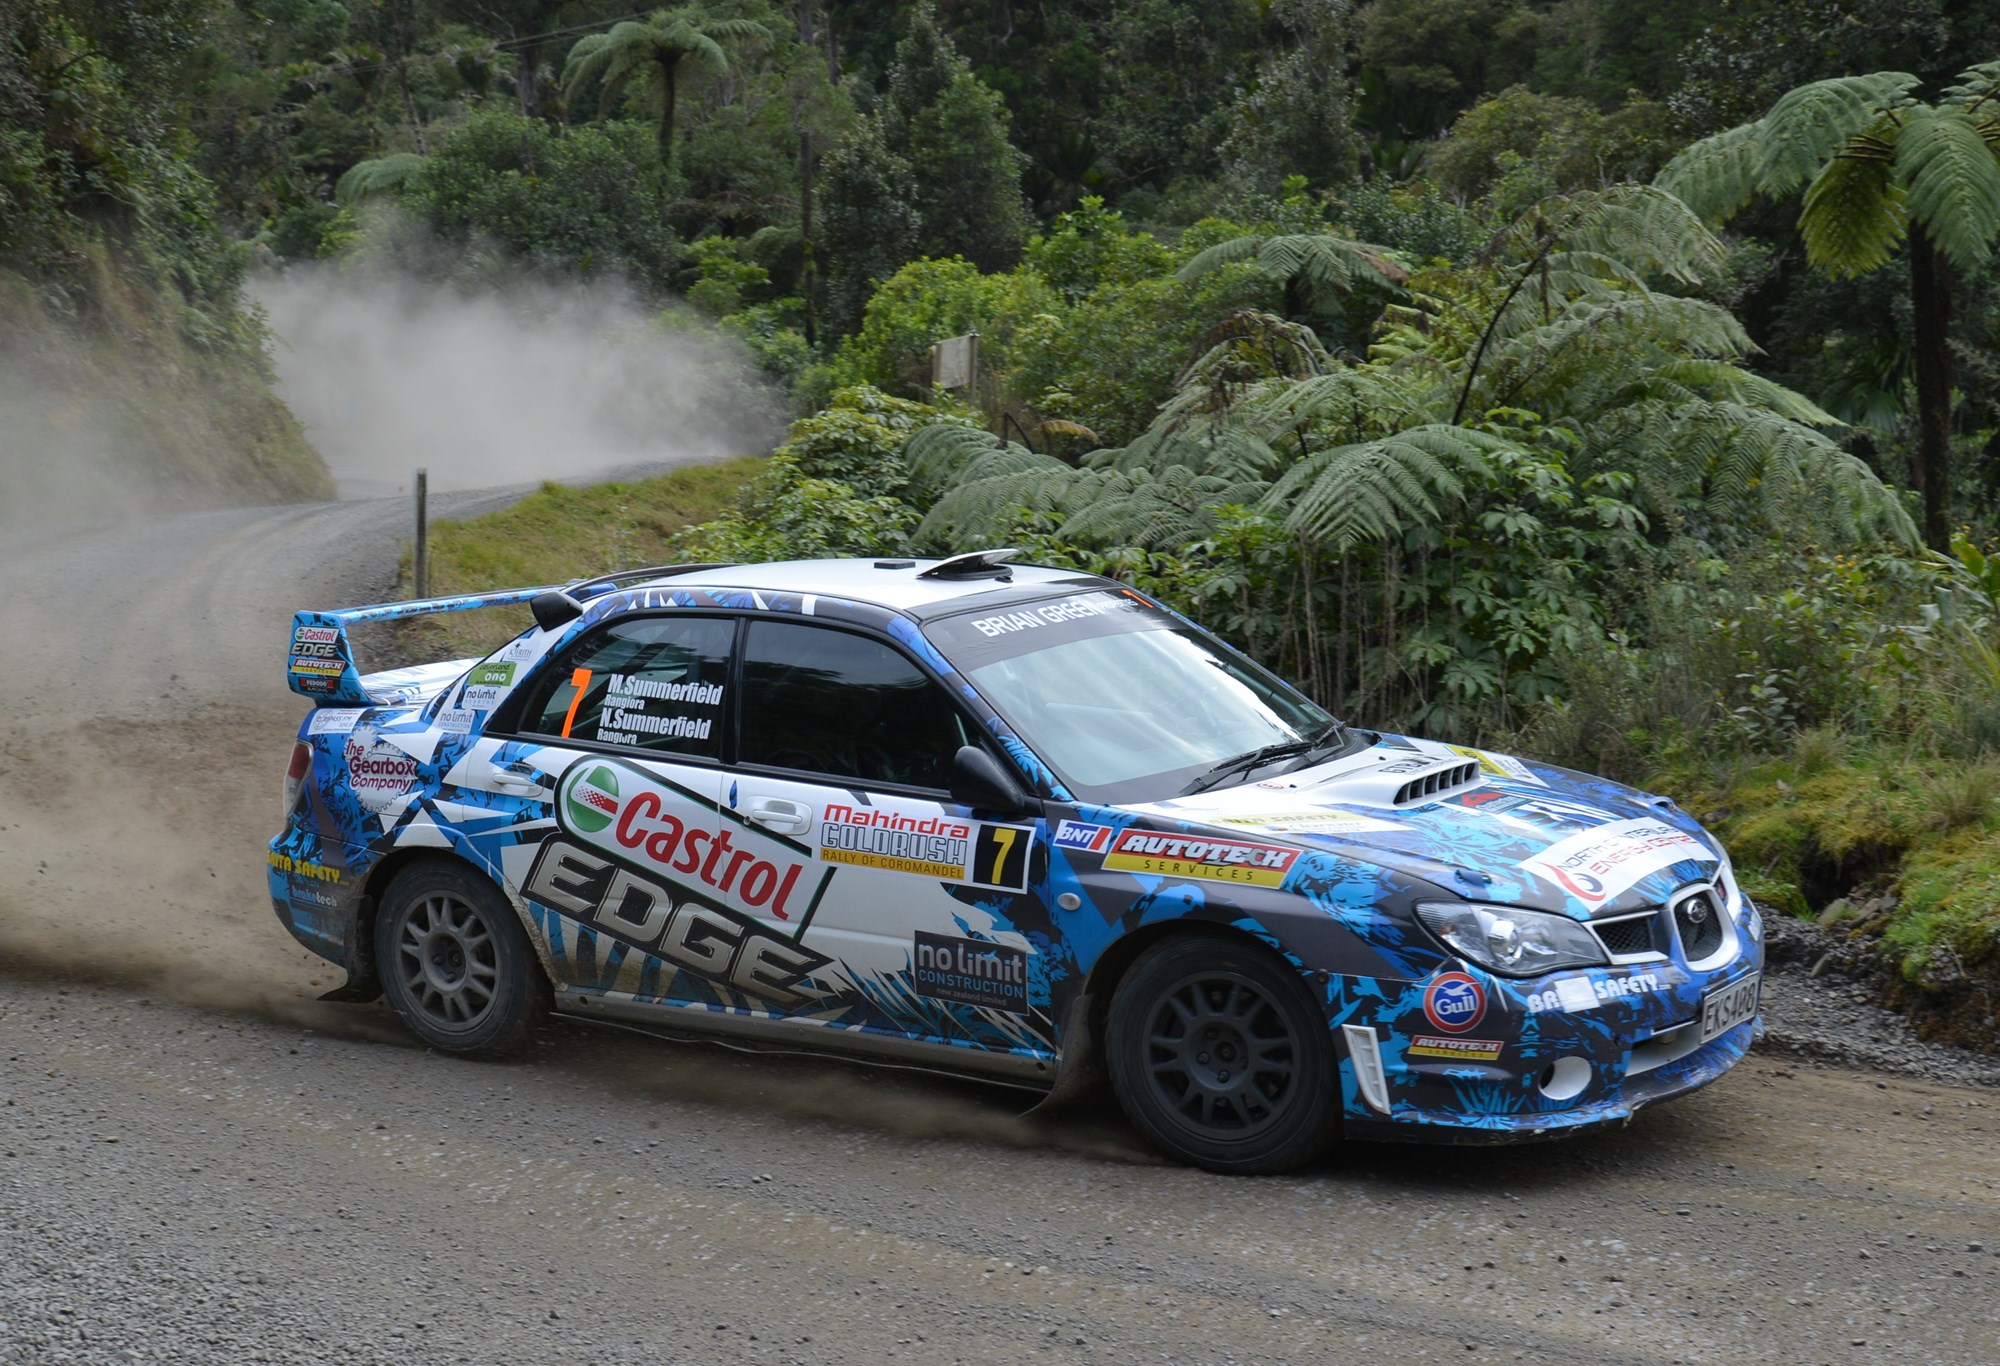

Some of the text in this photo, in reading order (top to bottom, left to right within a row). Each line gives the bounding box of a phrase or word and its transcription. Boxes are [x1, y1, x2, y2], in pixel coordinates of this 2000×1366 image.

[971, 610, 1047, 637] BRIAN
[1037, 600, 1104, 623] GREEN
[304, 629, 337, 641] Castrol
[291, 643, 337, 657] EDGE
[466, 689, 497, 700] no limit
[561, 668, 593, 738] 7
[604, 694, 645, 710] Rangiora
[607, 673, 724, 705] M.Summerfield
[440, 710, 473, 723] no limit
[599, 707, 712, 740] N.Summerfield
[346, 738, 364, 756] The
[597, 728, 637, 744] Rangiora
[349, 756, 415, 775] Gearbox
[351, 774, 411, 791] Company
[824, 804, 970, 839] Mahindra
[1062, 828, 1095, 843] BNT
[616, 792, 803, 921] Castrol
[821, 822, 967, 866] GOLDRUSH
[991, 827, 1017, 885] 7
[1121, 834, 1291, 868] AUTOTECH
[1556, 844, 1606, 872] NORTH
[823, 849, 963, 879] RALLY OF COROMANDEL
[1145, 860, 1254, 880] SERVICES
[528, 841, 817, 1006] EDGE
[918, 943, 1022, 984] no limit
[919, 969, 1023, 999] CONSTRUCTION
[1435, 998, 1477, 1016] Gull
[1416, 1037, 1499, 1052] AUTOTECH
